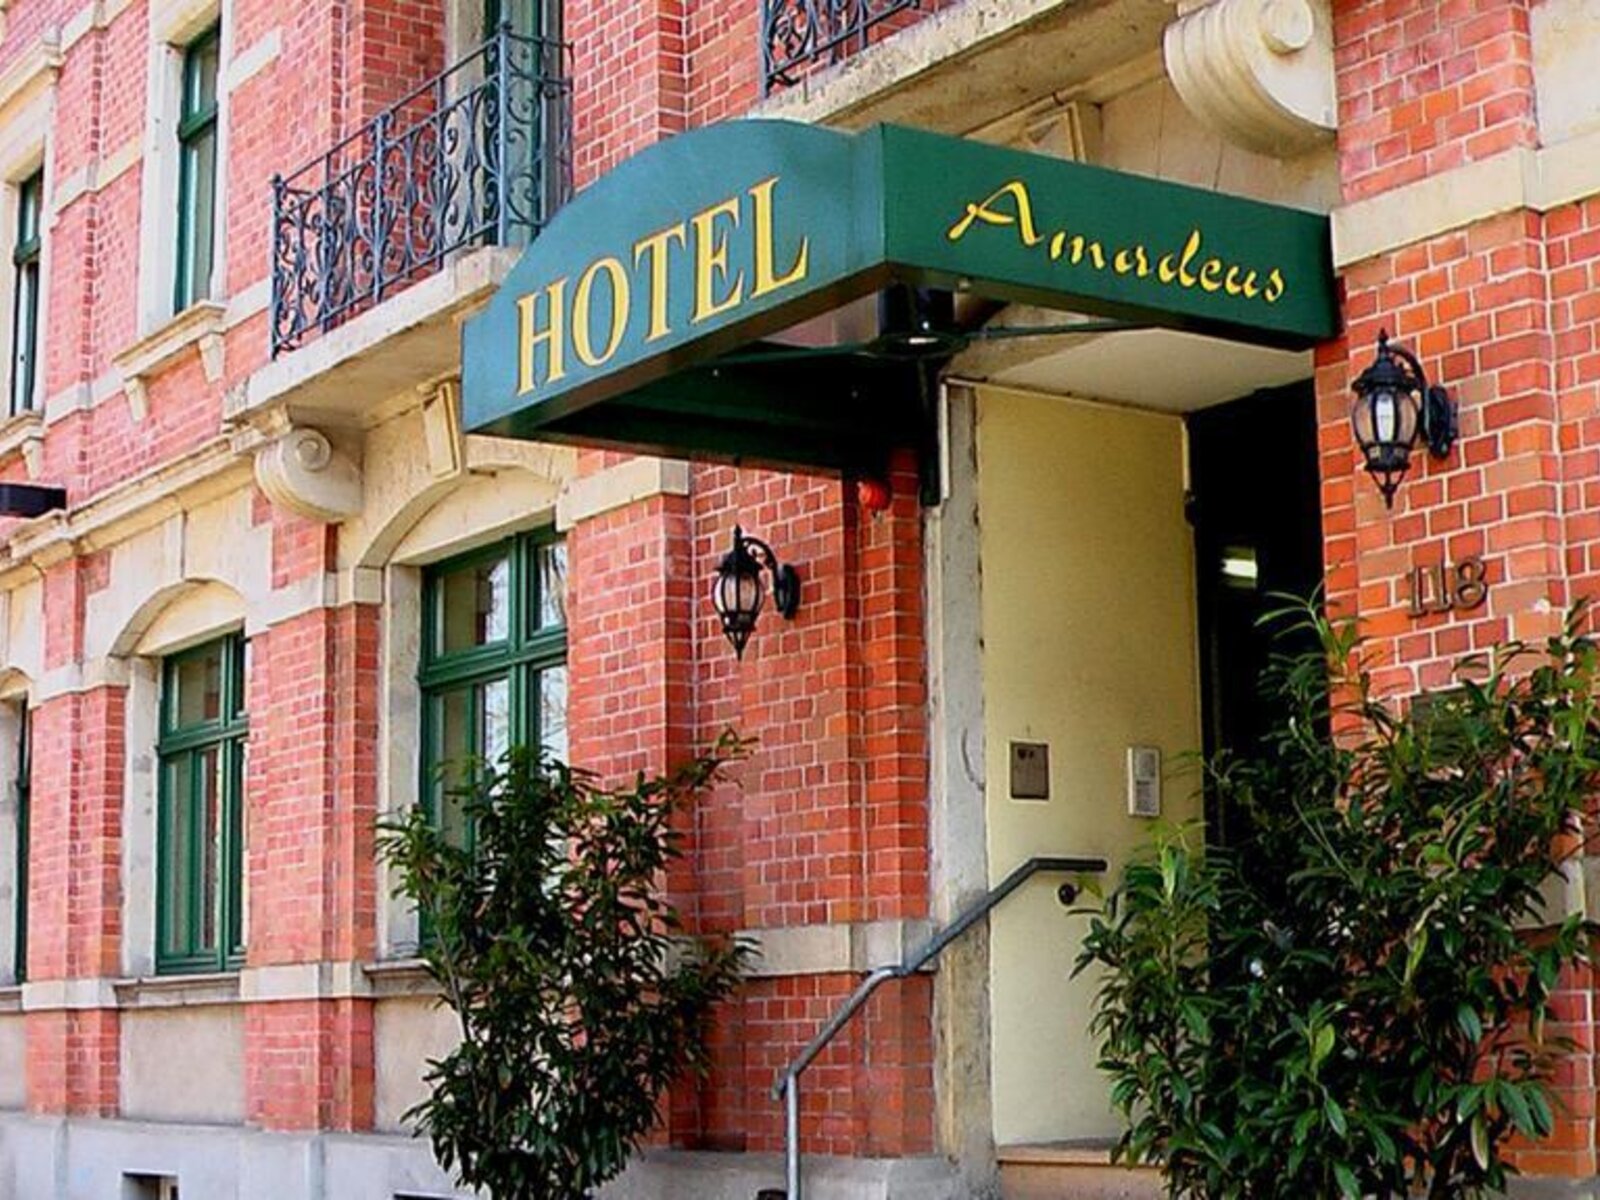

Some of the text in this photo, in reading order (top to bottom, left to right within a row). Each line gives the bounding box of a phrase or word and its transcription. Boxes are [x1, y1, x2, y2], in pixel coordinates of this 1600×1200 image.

[516, 176, 808, 397] HOTEL
[946, 181, 1285, 302] Amadeus
[1407, 556, 1488, 618] 118
